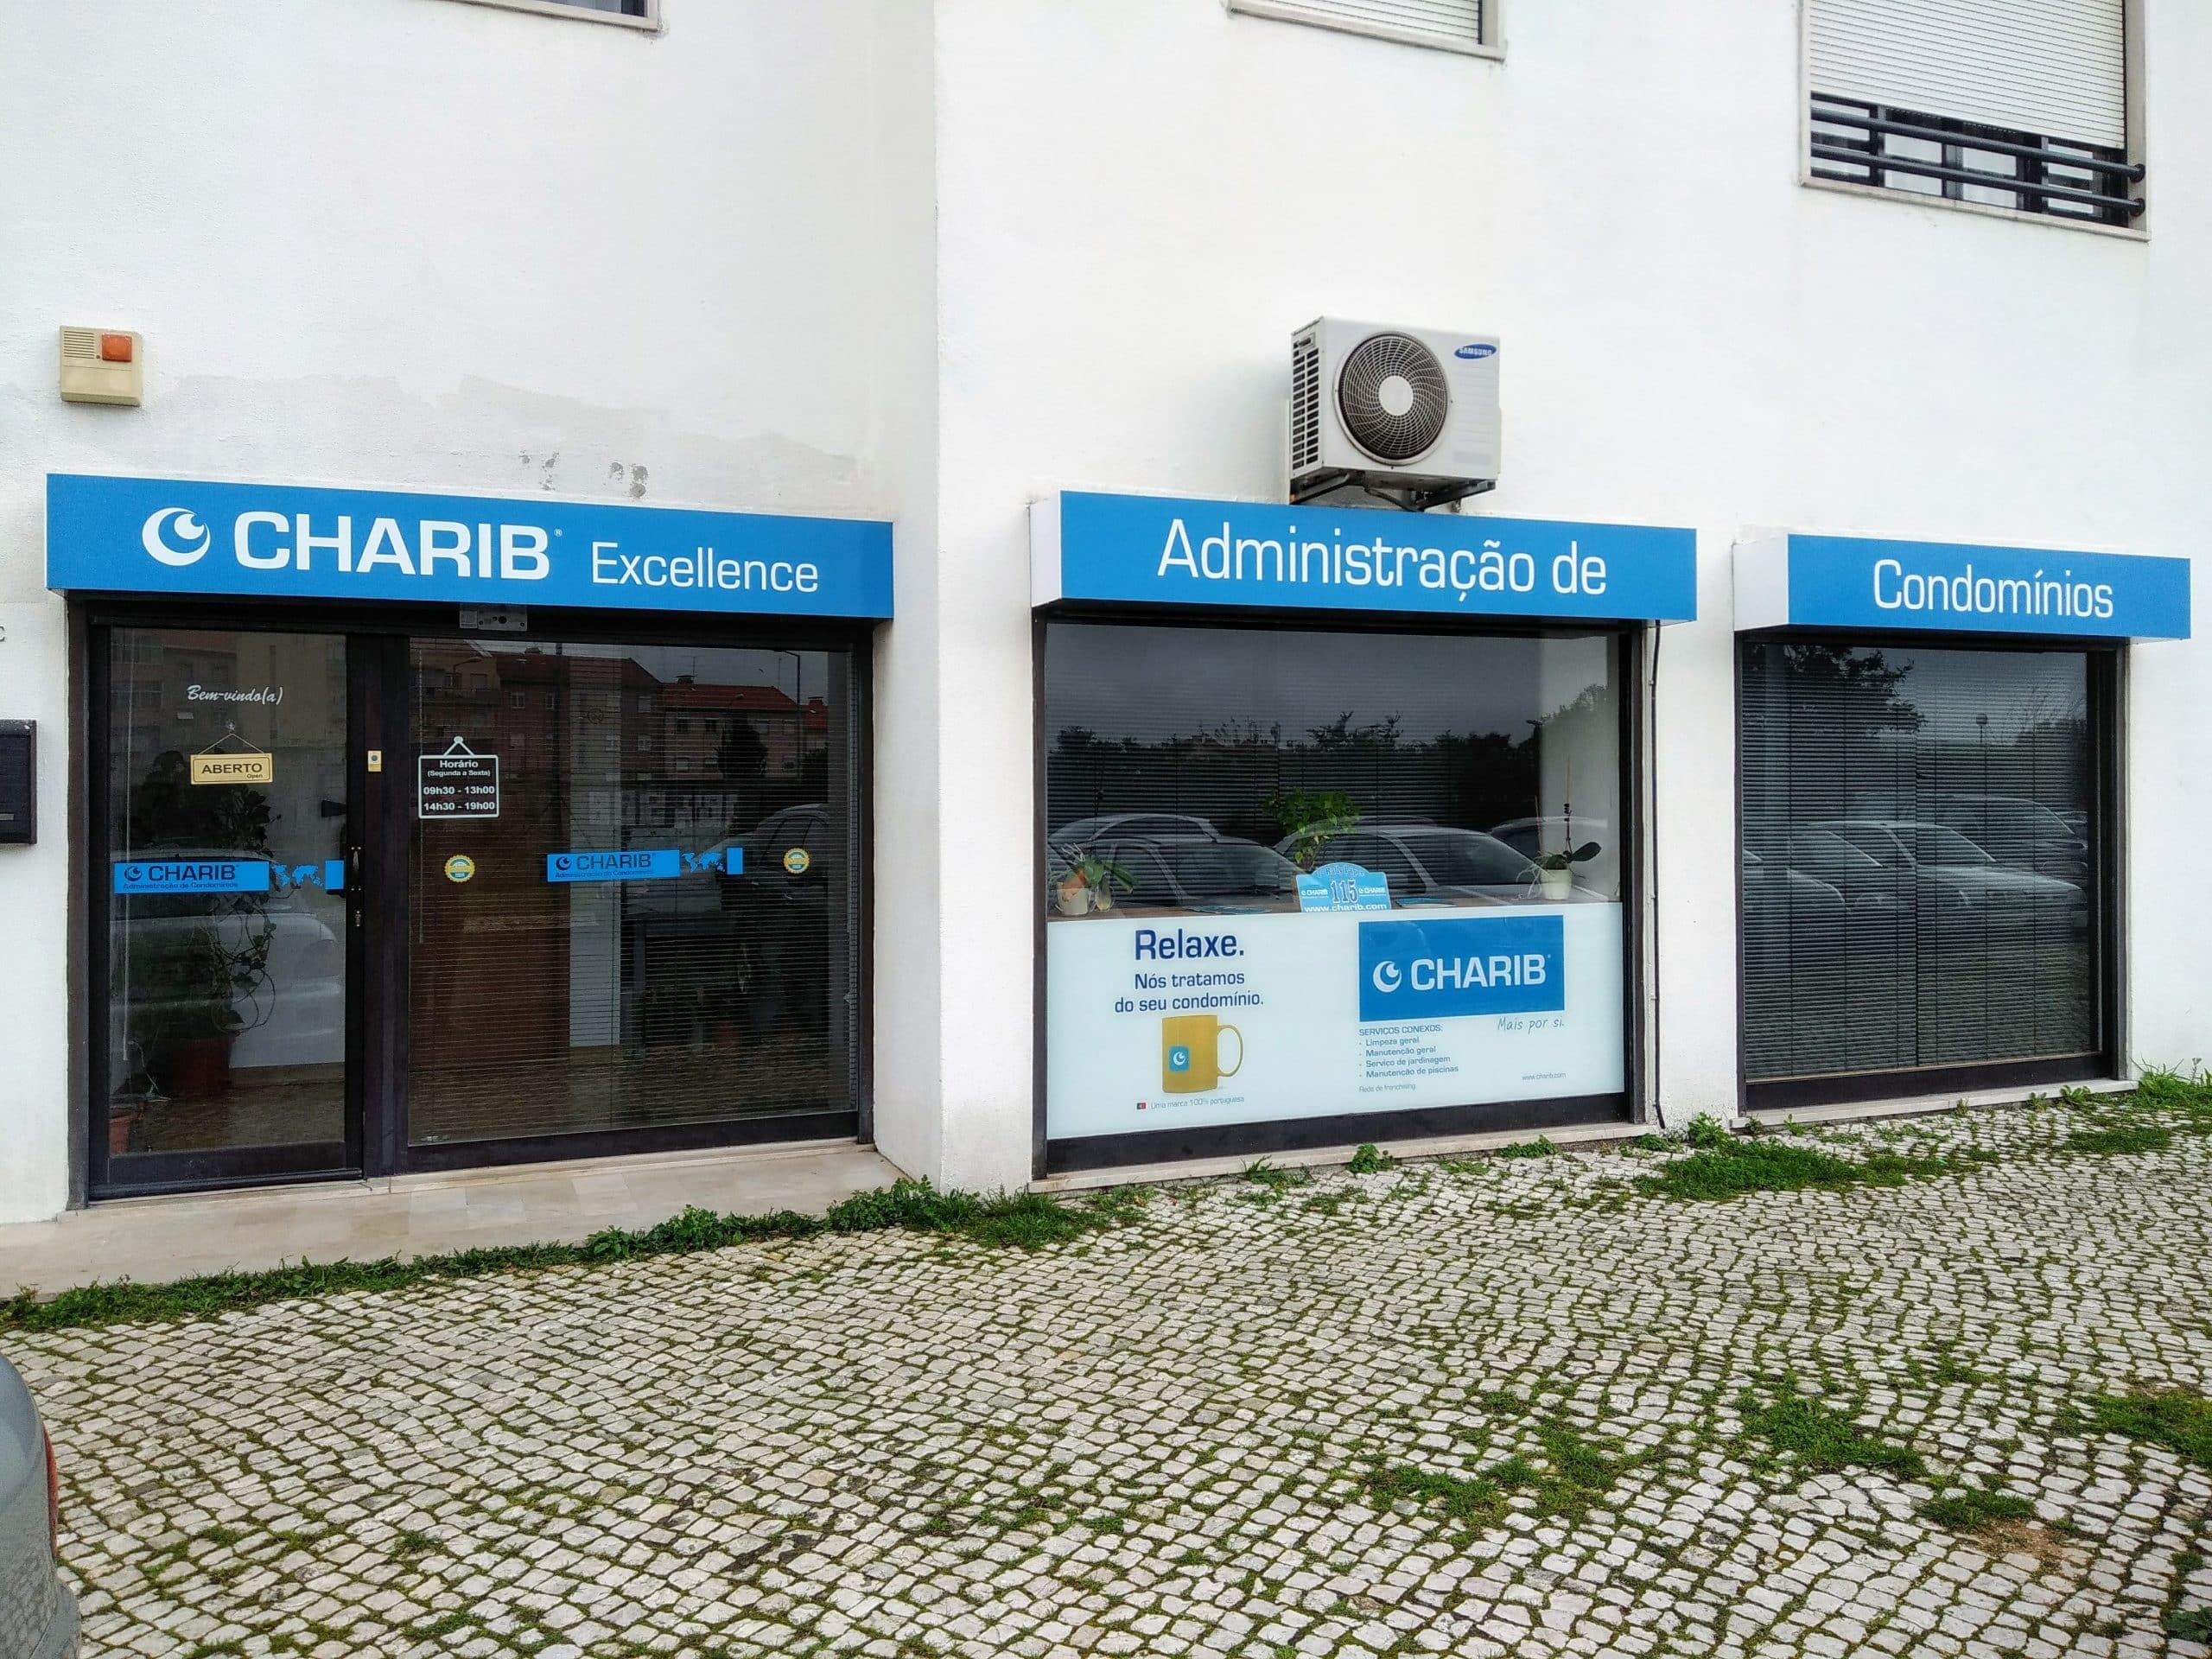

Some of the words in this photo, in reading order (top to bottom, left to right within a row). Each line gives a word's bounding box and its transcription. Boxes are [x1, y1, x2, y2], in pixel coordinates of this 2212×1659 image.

[1459, 346, 1493, 357] SAMSUNG
[233, 511, 550, 581] CHARIB
[591, 541, 819, 593] Excellence
[1157, 518, 1535, 602] Administração
[1552, 540, 1607, 595] de
[1873, 558, 2113, 619] Condomínios
[187, 684, 283, 705] Bem-vindo(a)
[201, 763, 263, 774] ABERTO
[423, 786, 455, 795] 09h30
[464, 785, 495, 794] 13h00
[423, 802, 455, 810] 14h30
[464, 802, 495, 810] 19h00
[576, 854, 652, 870] CHARIB
[148, 864, 236, 881] CHARIB
[1330, 880, 1359, 904] 115
[1304, 903, 1388, 912] www.charib.com
[1135, 928, 1245, 961] Relaxe.
[1135, 973, 1166, 989] Nós
[1172, 972, 1245, 988] tratamos
[1410, 954, 1547, 991] CHARIB
[1115, 997, 1134, 1013] do
[1139, 998, 1166, 1012] seu
[1172, 990, 1264, 1010] condomínio.
[1402, 1024, 1443, 1034] CONEXOS:
[1497, 1017, 1523, 1031] Mais
[1528, 1019, 1548, 1035] por
[1552, 1016, 1565, 1028] si.
[1365, 1039, 1398, 1047] Limpeza
[1400, 1037, 1420, 1046] geral
[1417, 1046, 1436, 1055] geral
[1408, 1056, 1451, 1066] jardinagem
[1428, 1065, 1459, 1075] piscinas
